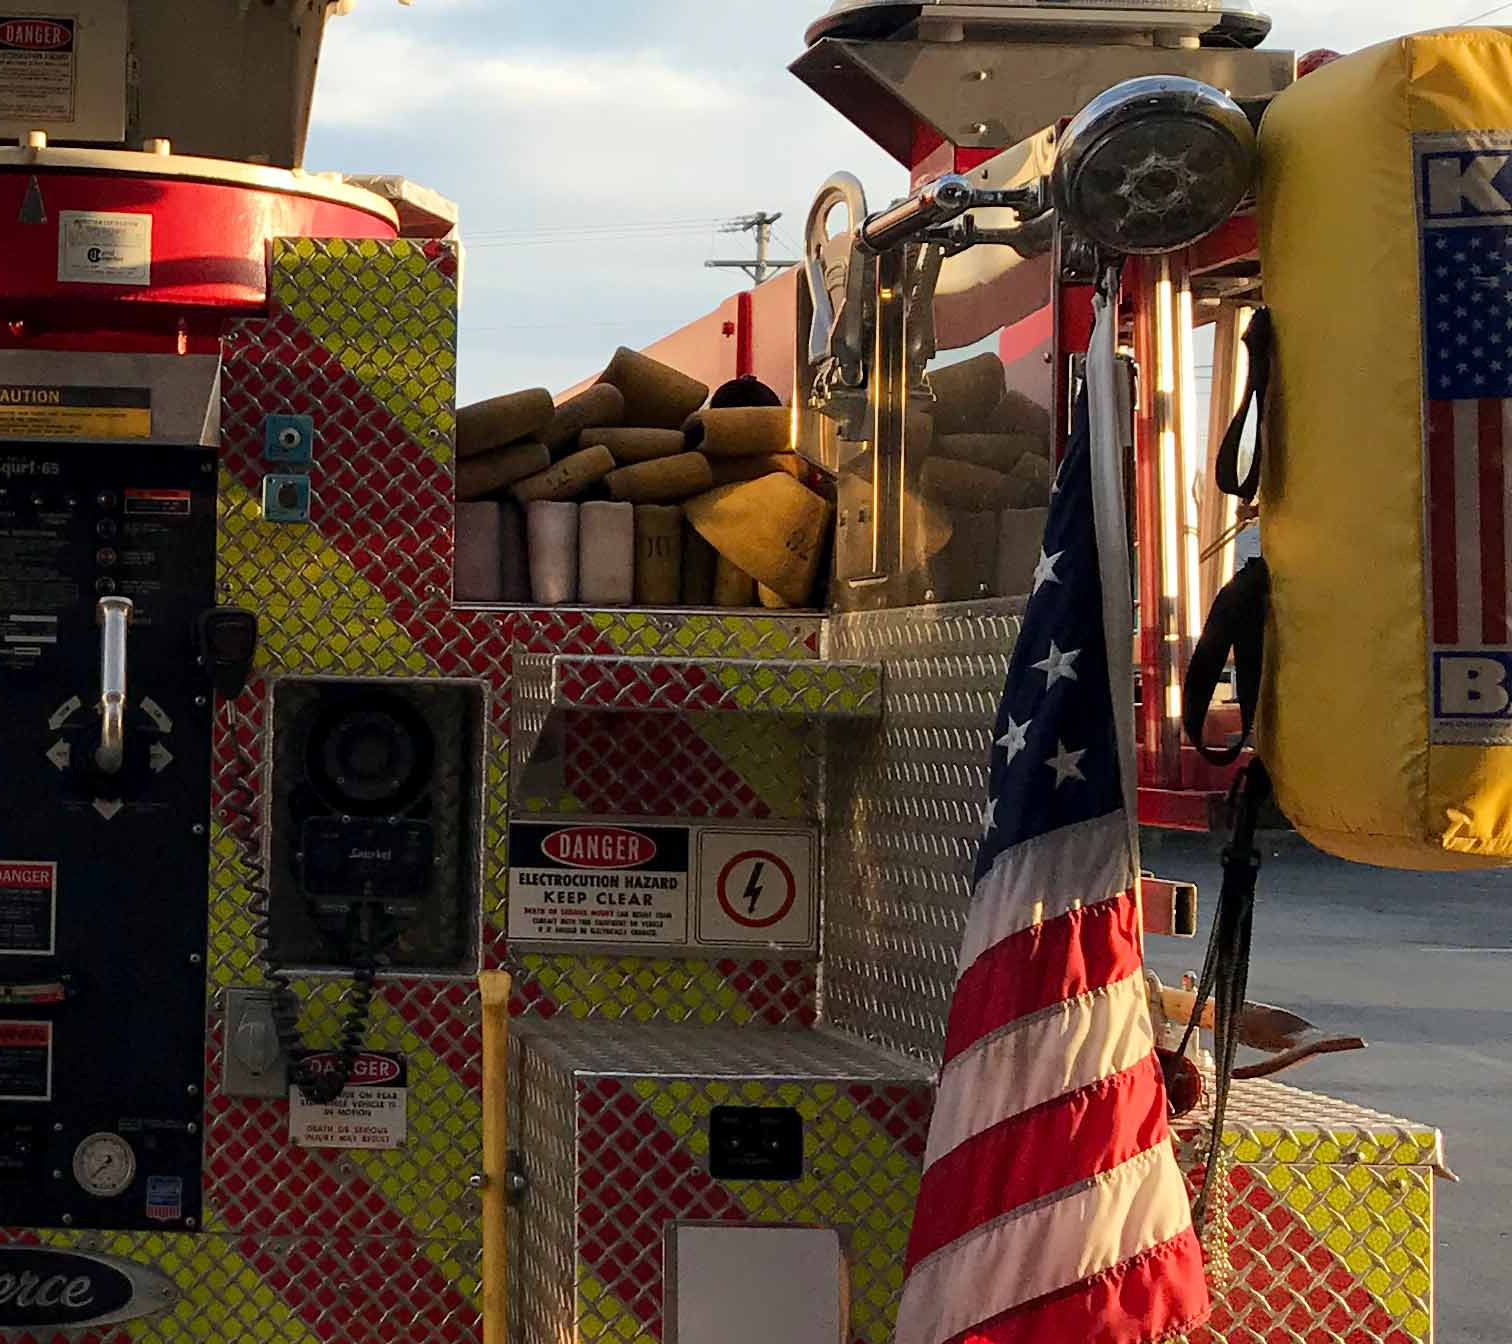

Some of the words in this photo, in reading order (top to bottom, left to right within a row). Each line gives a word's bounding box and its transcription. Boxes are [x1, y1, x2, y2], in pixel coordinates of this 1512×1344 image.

[7, 23, 62, 45] DANGER
[558, 833, 640, 862] DANGER
[519, 872, 619, 888] ELECTROCUTION
[624, 875, 678, 890] HAZARD
[544, 891, 586, 904] KEEP
[596, 892, 653, 906] CLEAR
